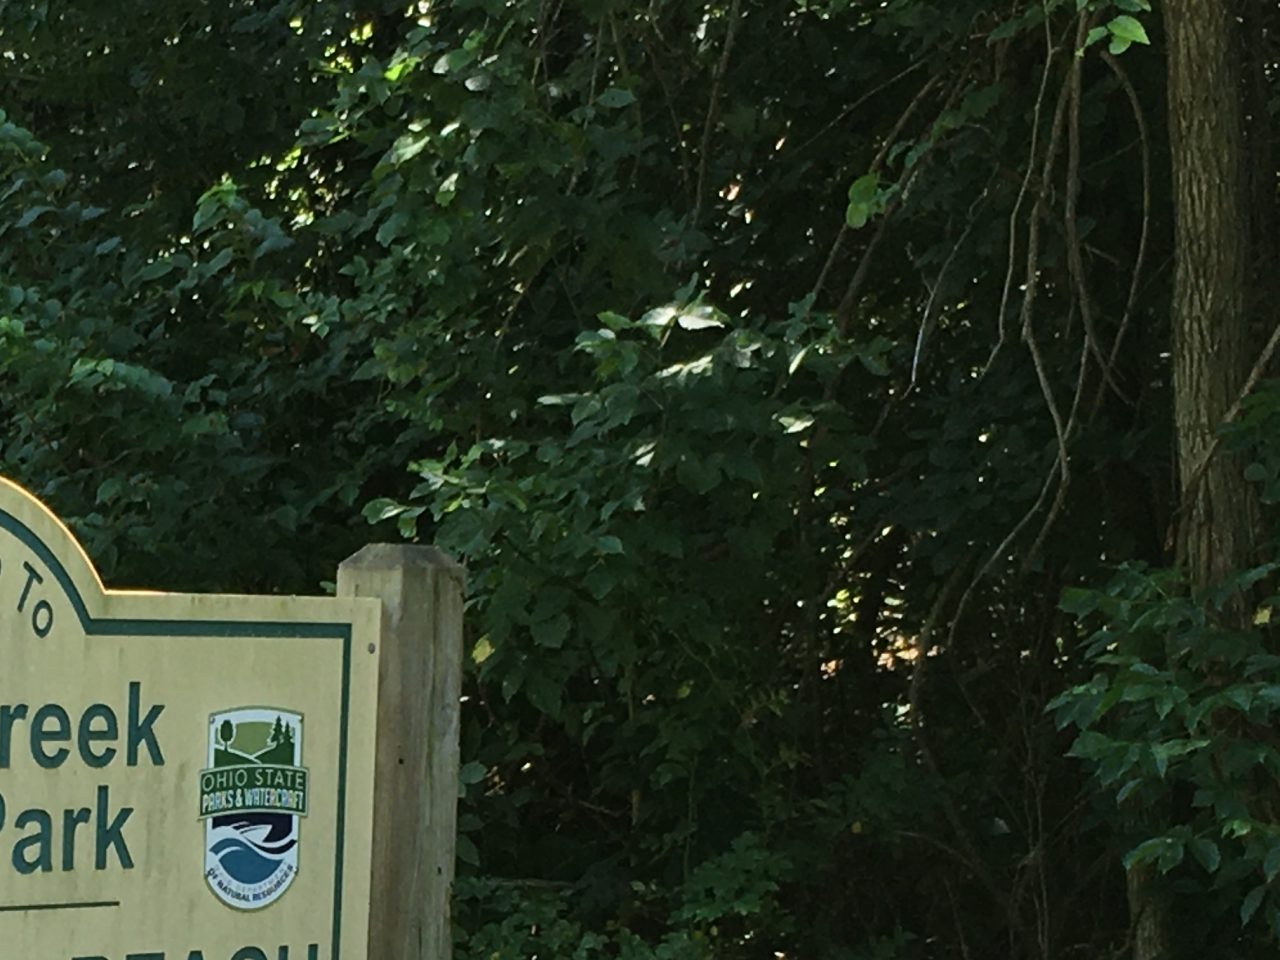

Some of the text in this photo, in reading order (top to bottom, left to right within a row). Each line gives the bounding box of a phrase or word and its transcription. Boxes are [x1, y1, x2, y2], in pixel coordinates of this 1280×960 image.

[17, 560, 54, 639] To
[202, 768, 304, 792] OHIO STATE
[202, 788, 235, 813] PARKS
[235, 788, 243, 808] &
